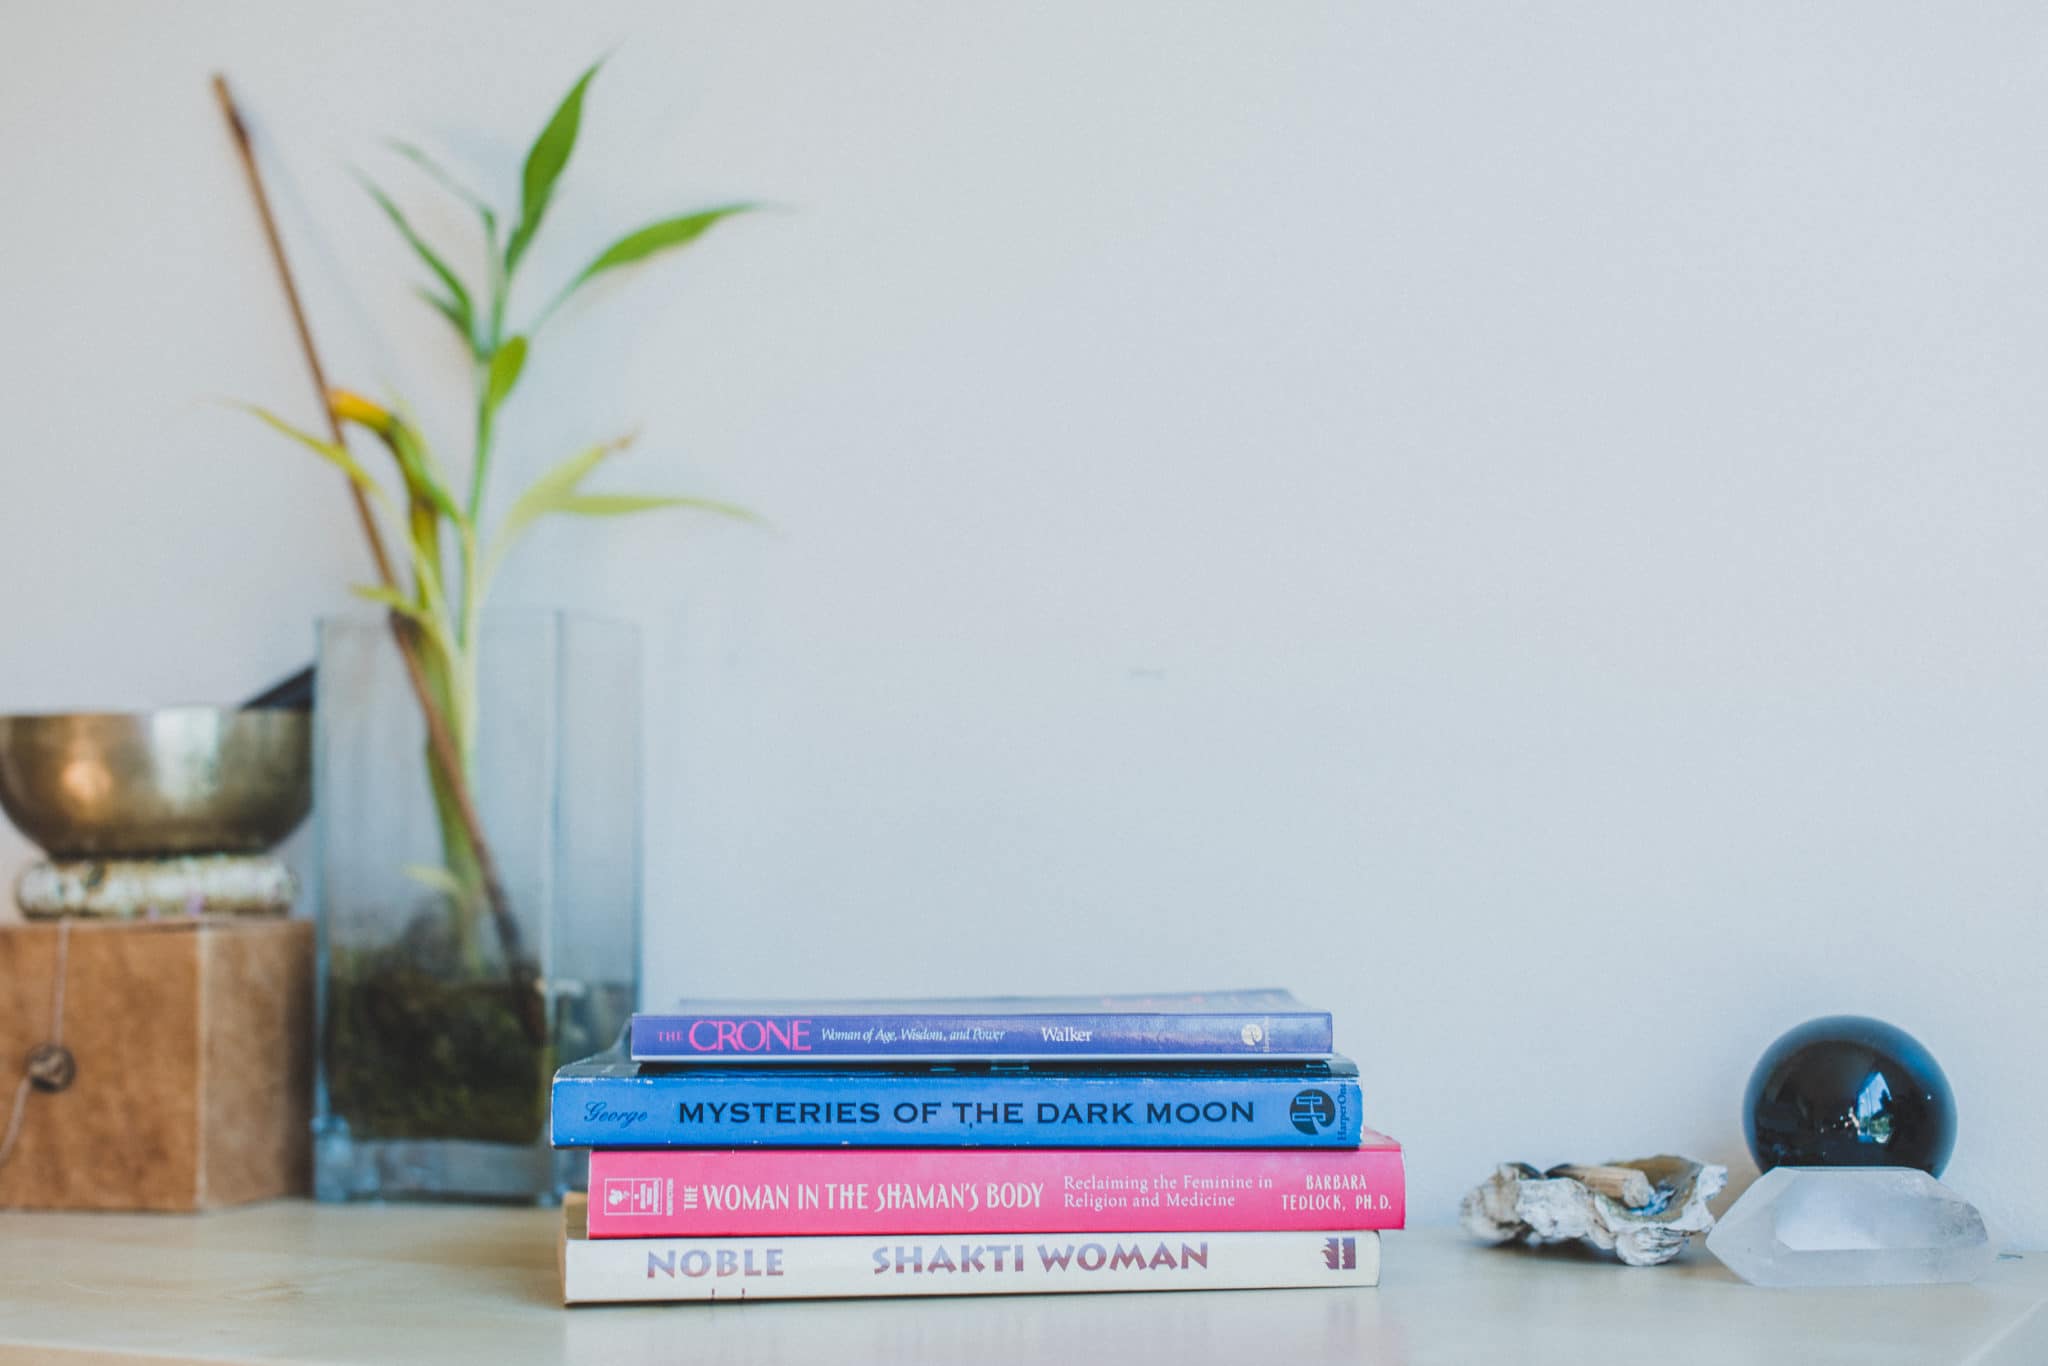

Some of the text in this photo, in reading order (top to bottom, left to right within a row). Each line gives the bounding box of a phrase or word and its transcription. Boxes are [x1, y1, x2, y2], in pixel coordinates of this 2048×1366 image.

[659, 1020, 812, 1051] THE CRONE
[821, 1028, 1006, 1044] Woman of Age, Wisdom, and Power
[1041, 1027, 1093, 1042] Walker
[583, 1101, 648, 1129] George
[679, 1101, 1254, 1124] MYSTERIES OF THE DARK MOON
[1064, 1174, 1272, 1192] Reclaiming the Feminine in
[1305, 1174, 1367, 1190] BARBARA
[683, 1185, 698, 1210] THE
[703, 1184, 789, 1211] WOMAN
[798, 1184, 819, 1210] IN
[825, 1184, 868, 1210] THE
[875, 1183, 979, 1212] SHAMAN'S
[986, 1183, 1044, 1209] BODY
[1064, 1192, 1235, 1211] Religion and Medicine
[1281, 1194, 1346, 1212] TEDLOCK,
[647, 1249, 784, 1278] NOBLE
[873, 1242, 1208, 1274] SHAKTI WOMAN
